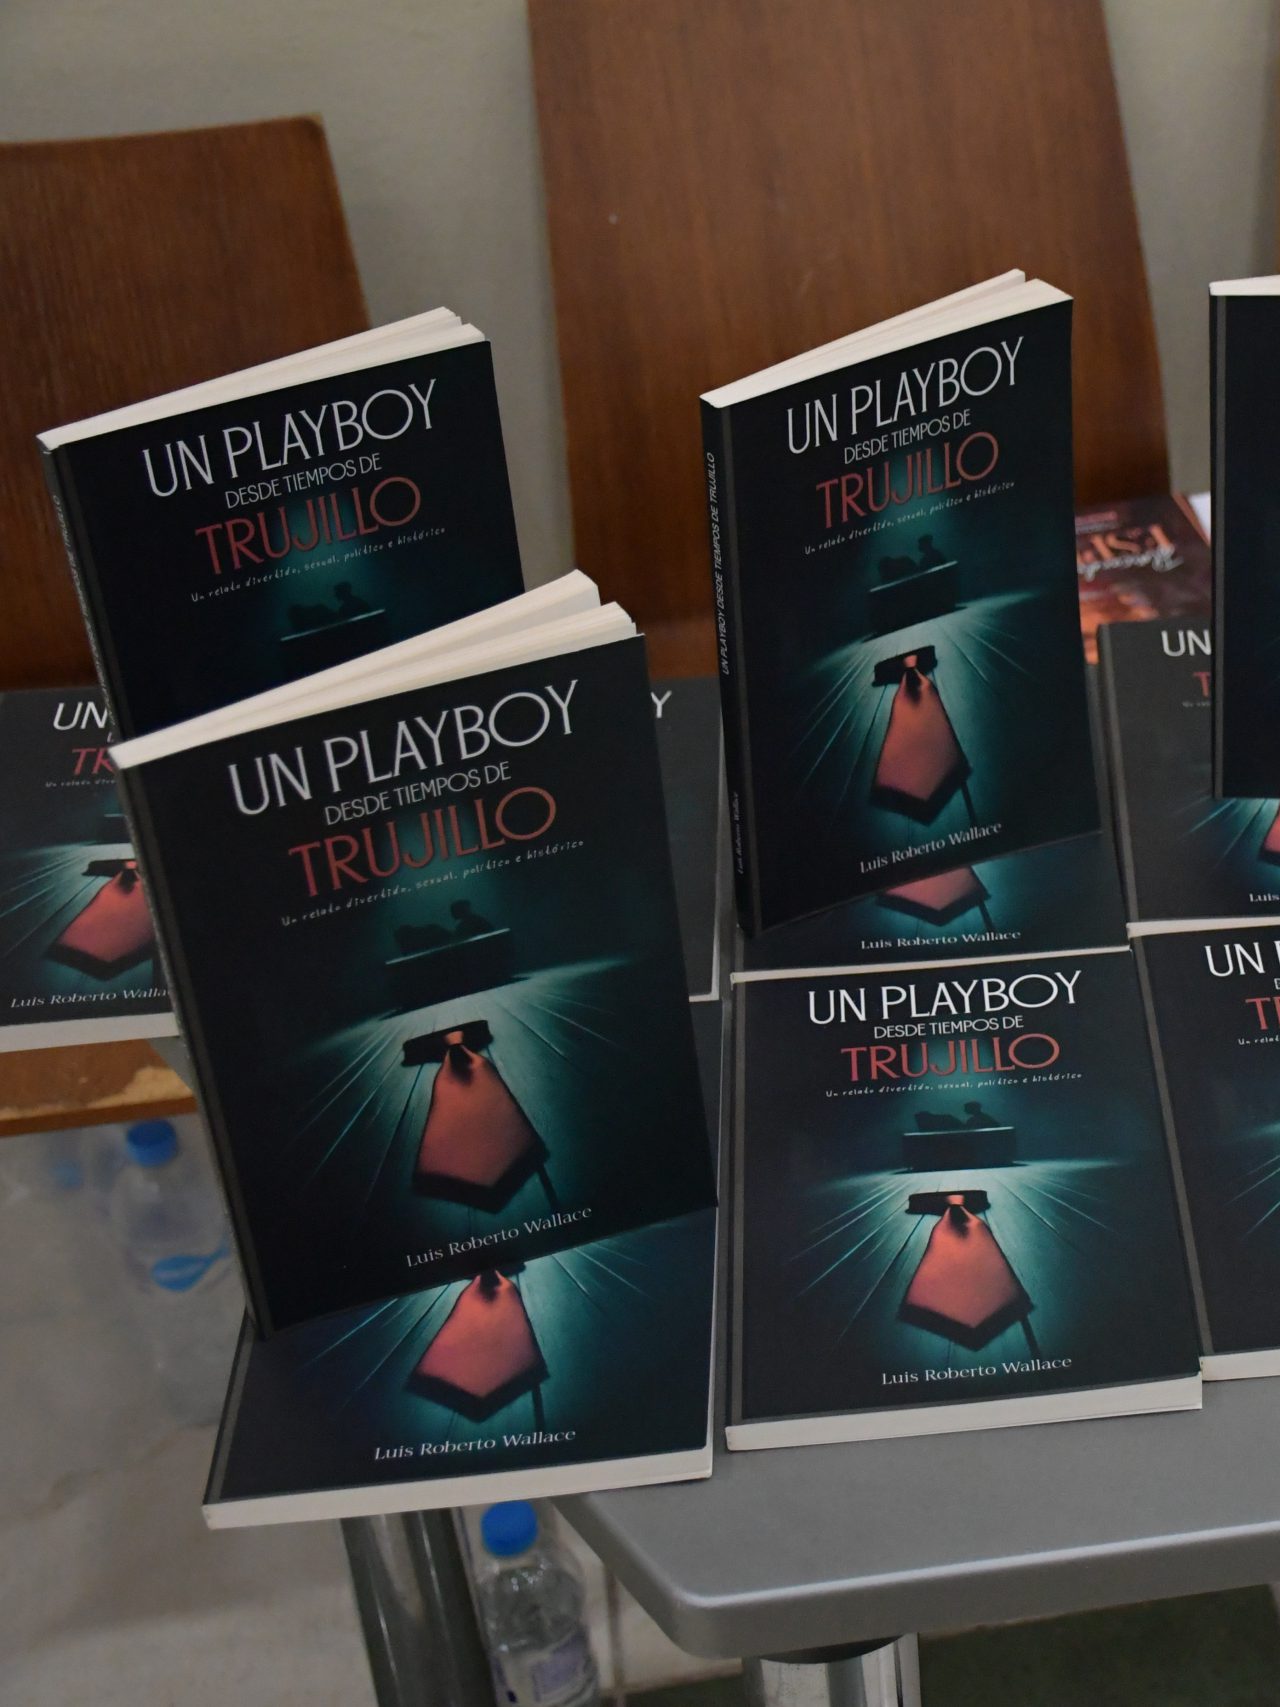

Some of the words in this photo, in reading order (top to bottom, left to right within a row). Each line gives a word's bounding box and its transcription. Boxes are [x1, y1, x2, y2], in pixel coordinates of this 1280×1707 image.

[788, 394, 837, 454] UN
[851, 337, 1023, 435] PLAYBOY
[143, 435, 214, 496] UN
[223, 379, 436, 478] PLAYBOY
[845, 435, 888, 464] DESDE
[891, 416, 950, 448] TIEMPOS
[953, 409, 971, 429] DE
[225, 479, 282, 508] DESDE
[283, 460, 356, 492] TIEMPOS
[359, 453, 381, 474] DE
[706, 452, 717, 502] TRUJILLO
[816, 431, 1000, 528] TRUJILLO
[195, 475, 421, 576] TRUJILLO
[710, 506, 720, 520] DE
[712, 523, 723, 571] TIEMPOS
[715, 571, 725, 610] DESDE
[717, 612, 729, 660] PLAYBOY
[1161, 629, 1212, 657] UN
[721, 660, 730, 676] UN
[52, 702, 108, 731] UN
[229, 747, 312, 814] UN
[324, 680, 578, 792] PLAYBOY
[325, 791, 391, 825] DESDE
[393, 769, 481, 806] TIEMPOS
[484, 761, 511, 784] DE
[288, 786, 557, 896] TRUJILLO
[860, 855, 889, 874] Luis
[891, 838, 946, 864] Roberto
[948, 822, 1003, 846] Wallace
[1250, 894, 1279, 902] Luis
[862, 940, 892, 949] Luis
[898, 937, 957, 947] Roberto
[962, 932, 1020, 942] Wallace
[1205, 942, 1265, 976] UN
[11, 997, 44, 1007] Luis
[51, 992, 116, 1004] Roberto
[809, 988, 866, 1024] UN
[881, 970, 1081, 1019] PLAYBOY
[874, 1023, 926, 1039] DESDE
[929, 1018, 999, 1034] TIEMPOS
[1003, 1015, 1023, 1029] DE
[840, 1033, 1061, 1083] TRUJILLO
[407, 1249, 443, 1267] Luis
[449, 1229, 519, 1255] Roberto
[524, 1209, 591, 1233] Wallace
[883, 1372, 918, 1384] Luis
[926, 1366, 996, 1381] Roberto
[1002, 1359, 1071, 1373] Wallace
[375, 1446, 413, 1460] Luis
[421, 1439, 495, 1455] Roberto
[503, 1432, 575, 1447] Wallace
